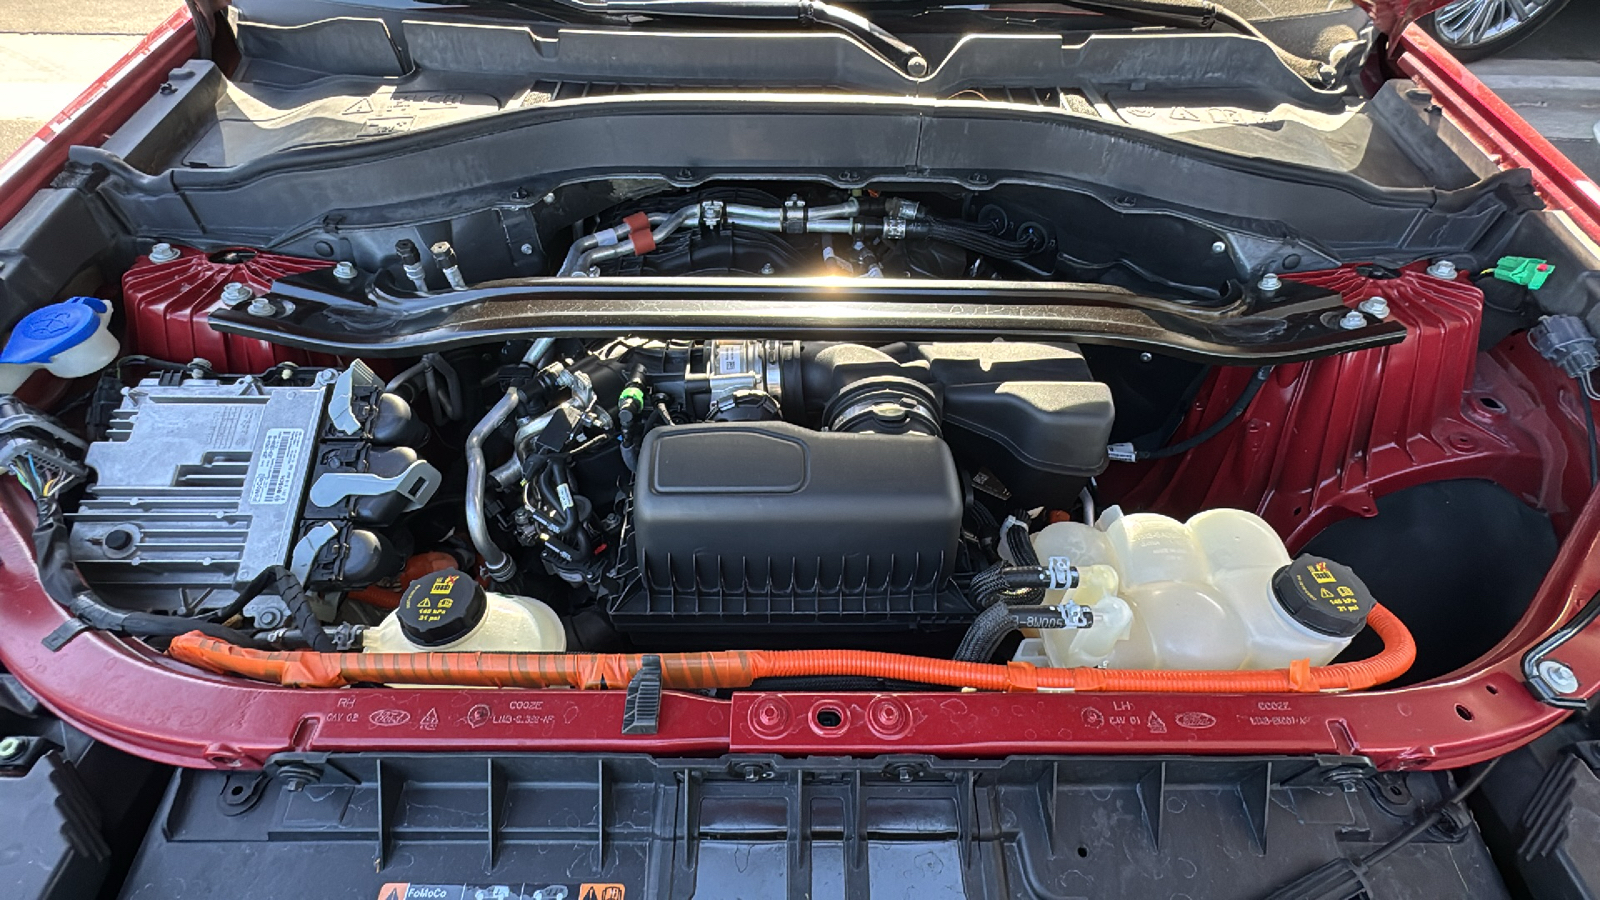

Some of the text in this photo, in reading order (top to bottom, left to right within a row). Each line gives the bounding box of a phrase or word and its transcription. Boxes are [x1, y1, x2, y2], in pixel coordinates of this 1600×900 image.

[337, 698, 356, 708] RH
[1113, 701, 1130, 711] LH
[372, 709, 406, 725] Ford
[408, 888, 447, 898] FoMoCo
